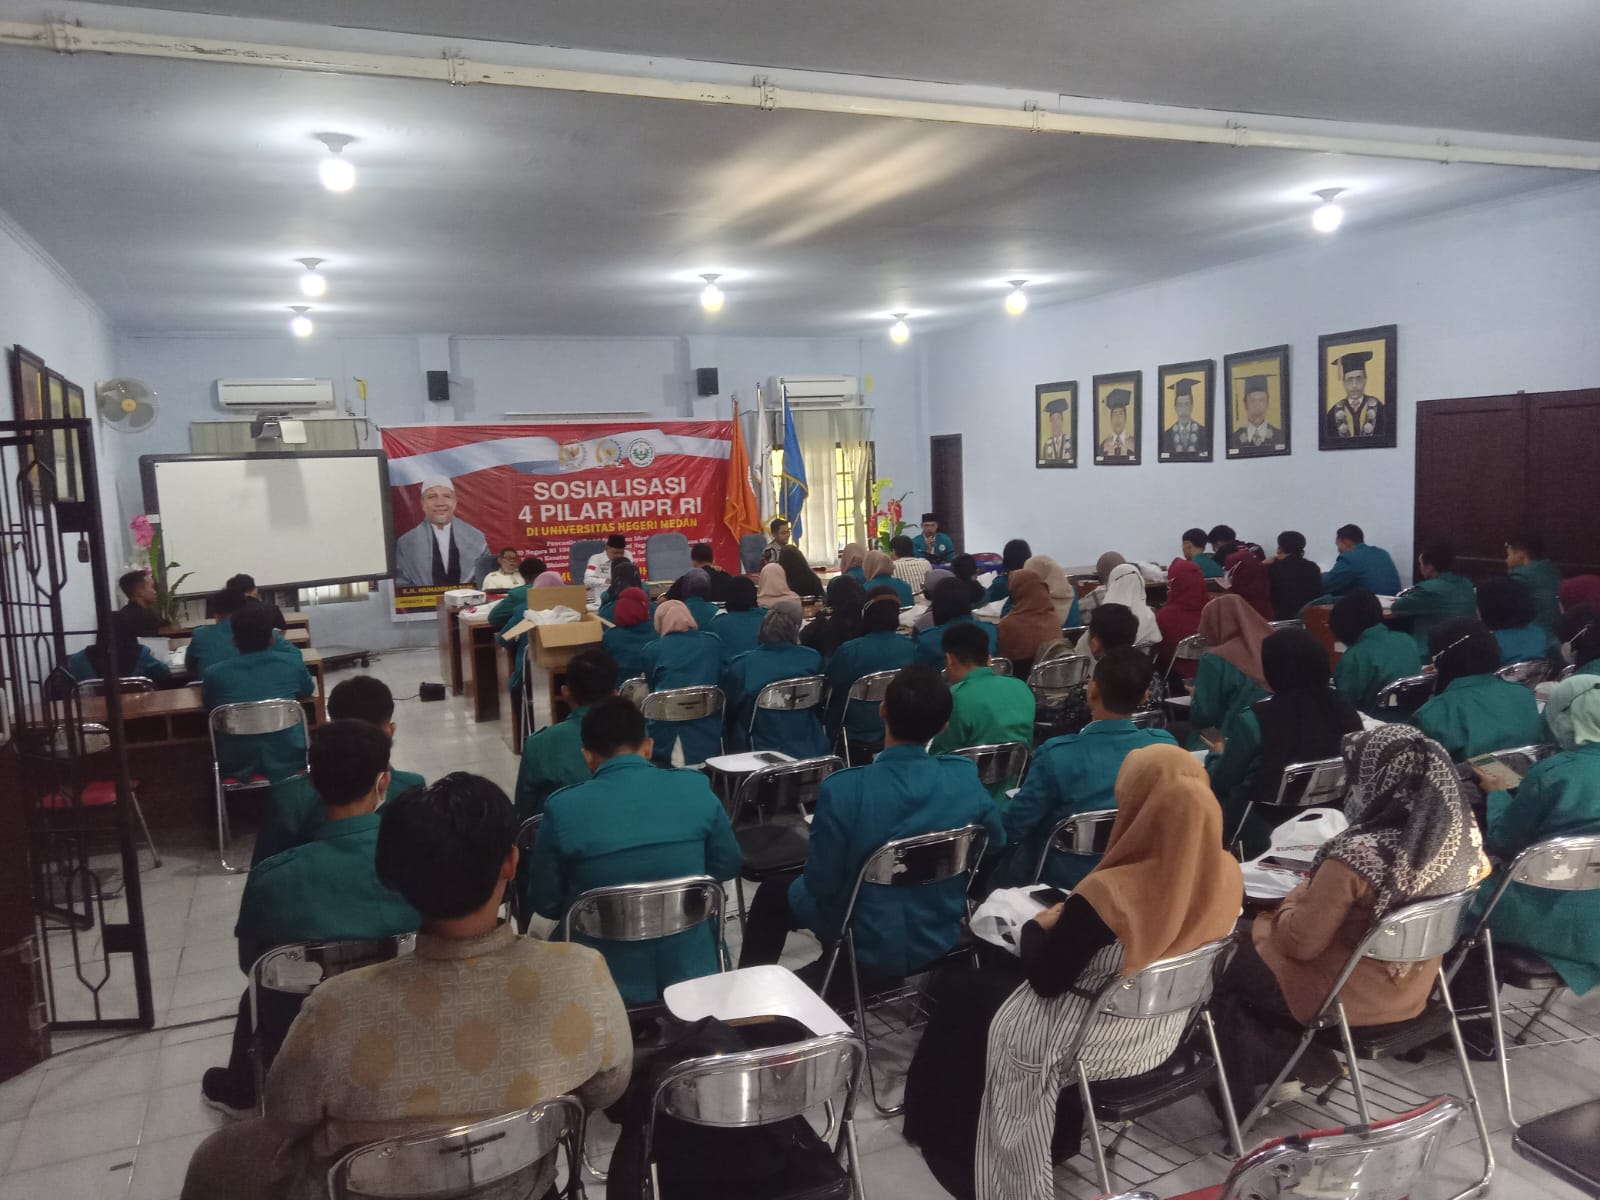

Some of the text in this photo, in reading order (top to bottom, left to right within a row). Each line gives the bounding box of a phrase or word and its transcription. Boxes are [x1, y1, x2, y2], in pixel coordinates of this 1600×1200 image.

[533, 476, 687, 500] SOSIALISASI
[518, 497, 702, 523] 4 PILAR MPR RI
[526, 518, 698, 537] DI UNIVERSITAS NEGERI MEDAN
